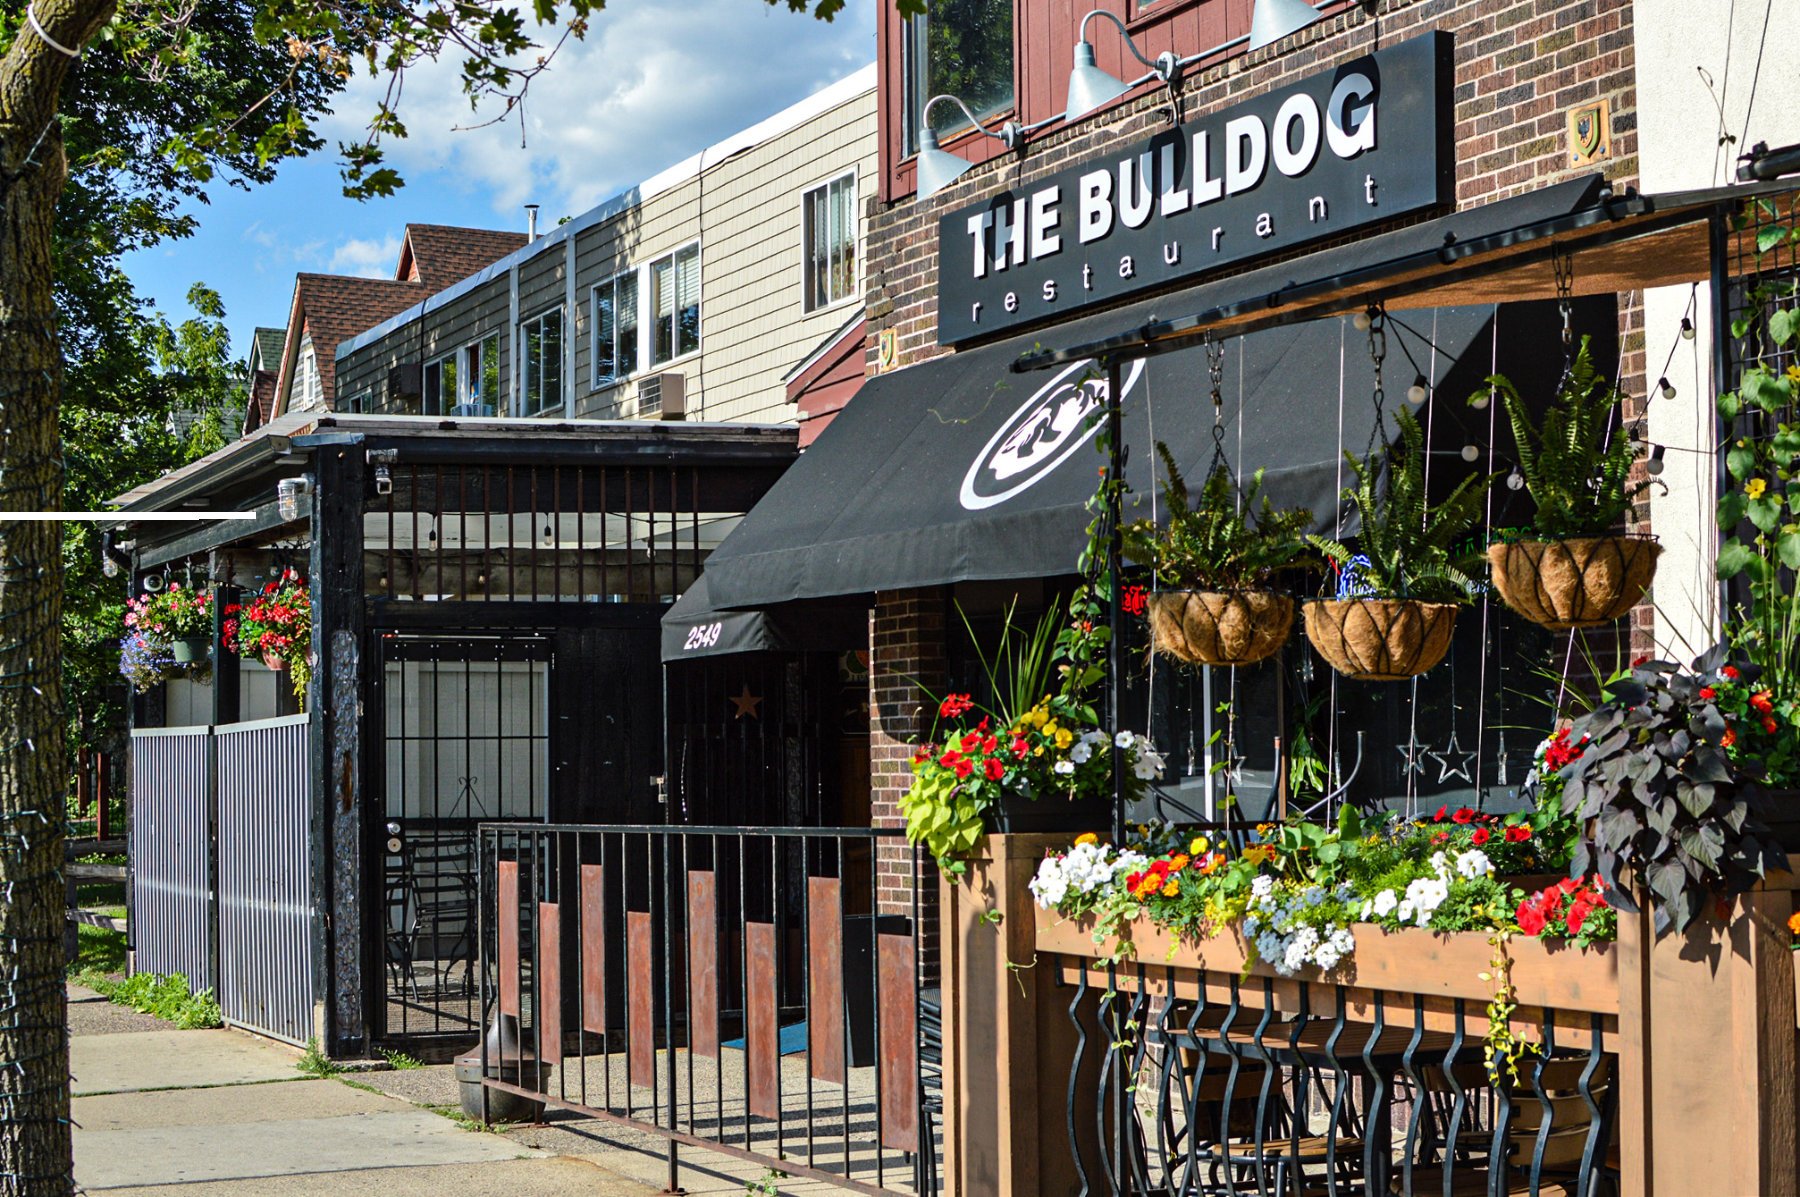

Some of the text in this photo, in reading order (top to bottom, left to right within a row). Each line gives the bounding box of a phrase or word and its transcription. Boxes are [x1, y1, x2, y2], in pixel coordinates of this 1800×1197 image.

[967, 73, 1376, 278] THE BULLDOG
[972, 174, 1378, 323] restaurant
[683, 622, 722, 650] 2549
